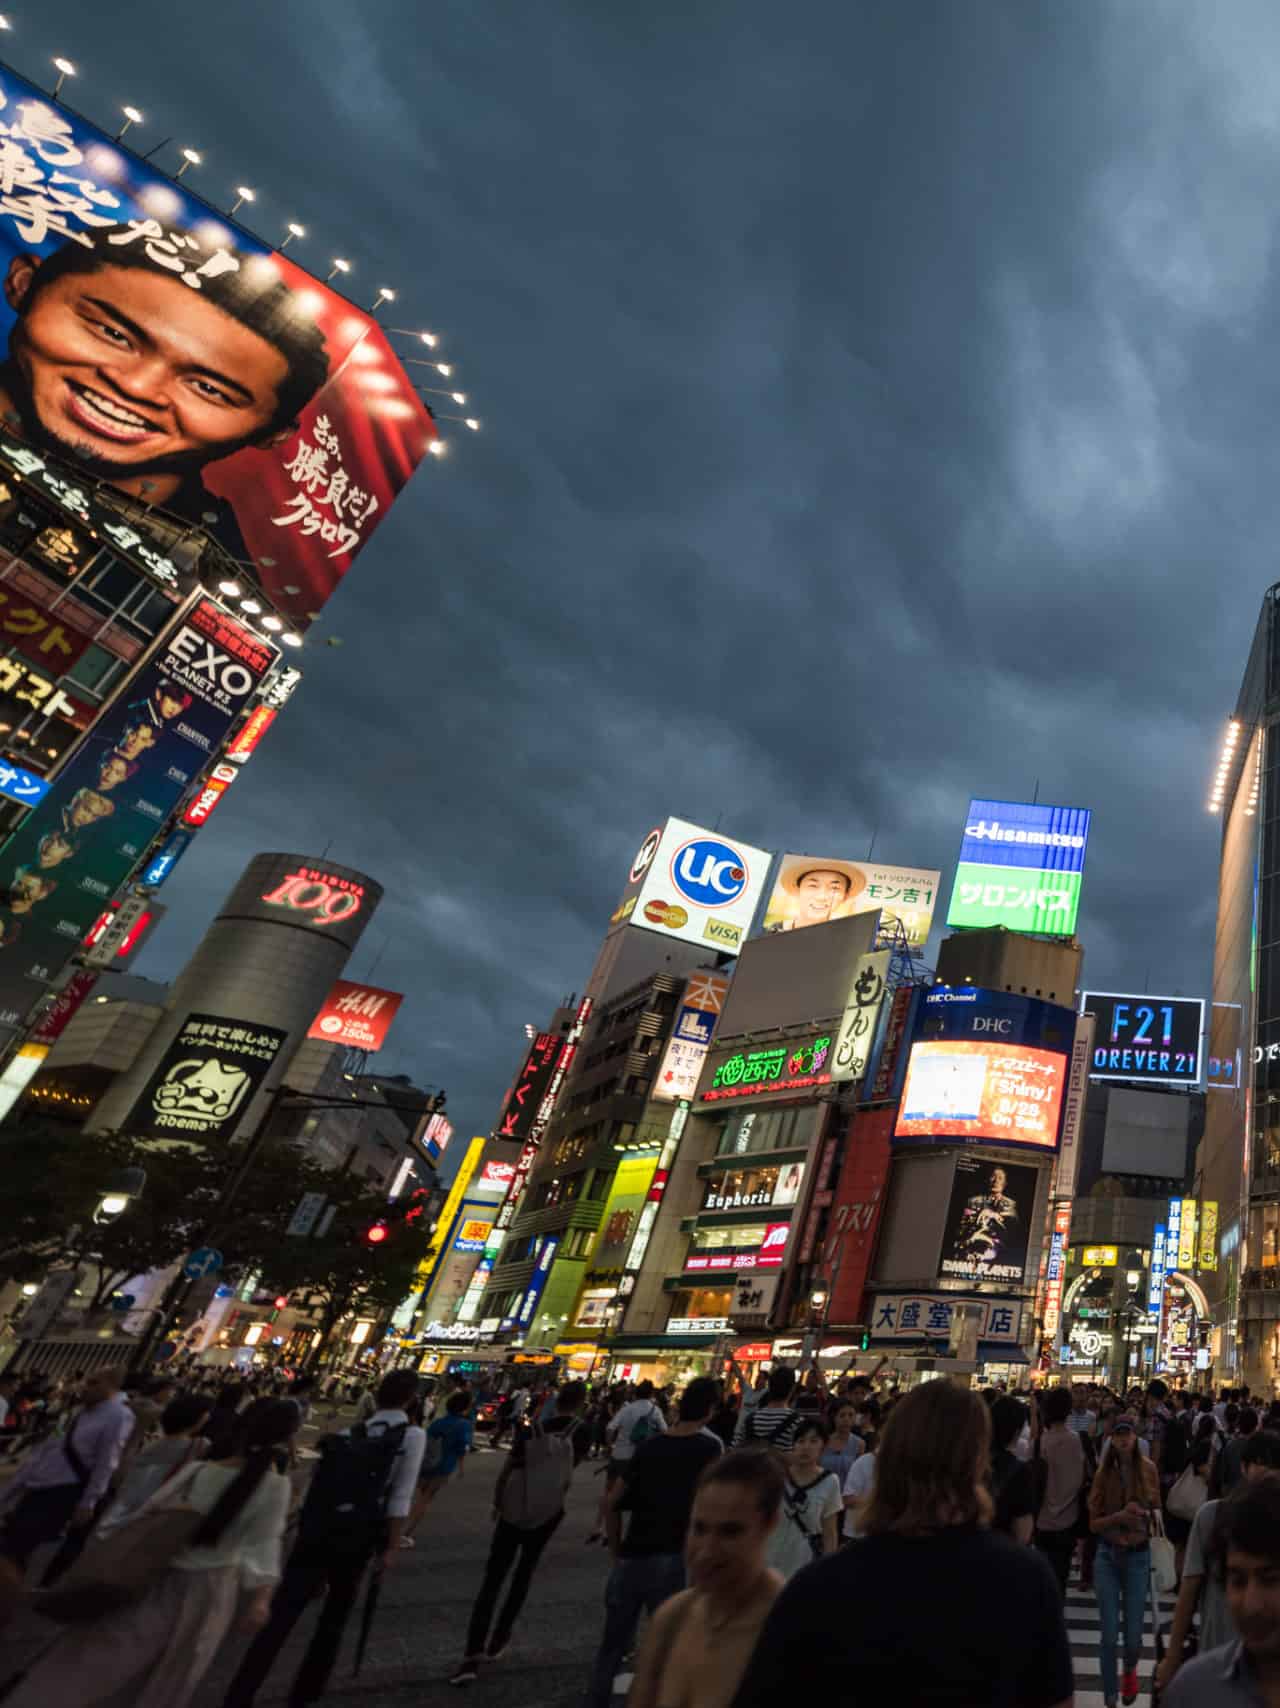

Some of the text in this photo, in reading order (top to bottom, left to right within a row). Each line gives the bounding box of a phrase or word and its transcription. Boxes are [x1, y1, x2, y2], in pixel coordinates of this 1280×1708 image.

[283, 440, 379, 529] 勝負だ!
[271, 492, 360, 558] クラロワ
[164, 655, 214, 694] PLANET
[167, 624, 253, 697] EXO
[299, 867, 365, 898] SHIBUYA
[679, 846, 742, 895] UC
[261, 873, 362, 926] 109
[959, 880, 1071, 913] サロンパス
[708, 924, 740, 942] VISA
[335, 989, 389, 1020] H&M
[687, 976, 729, 1011] 本
[183, 1022, 280, 1051] 無料で楽しめる
[972, 1016, 1012, 1034] DHC
[1111, 1003, 1175, 1046] F21
[1093, 1046, 1170, 1073] OREVER
[1174, 1050, 1196, 1074] 21
[991, 1114, 1015, 1127] On
[704, 1190, 771, 1211] Euphoria
[876, 1302, 1013, 1334] 大盛堂店
